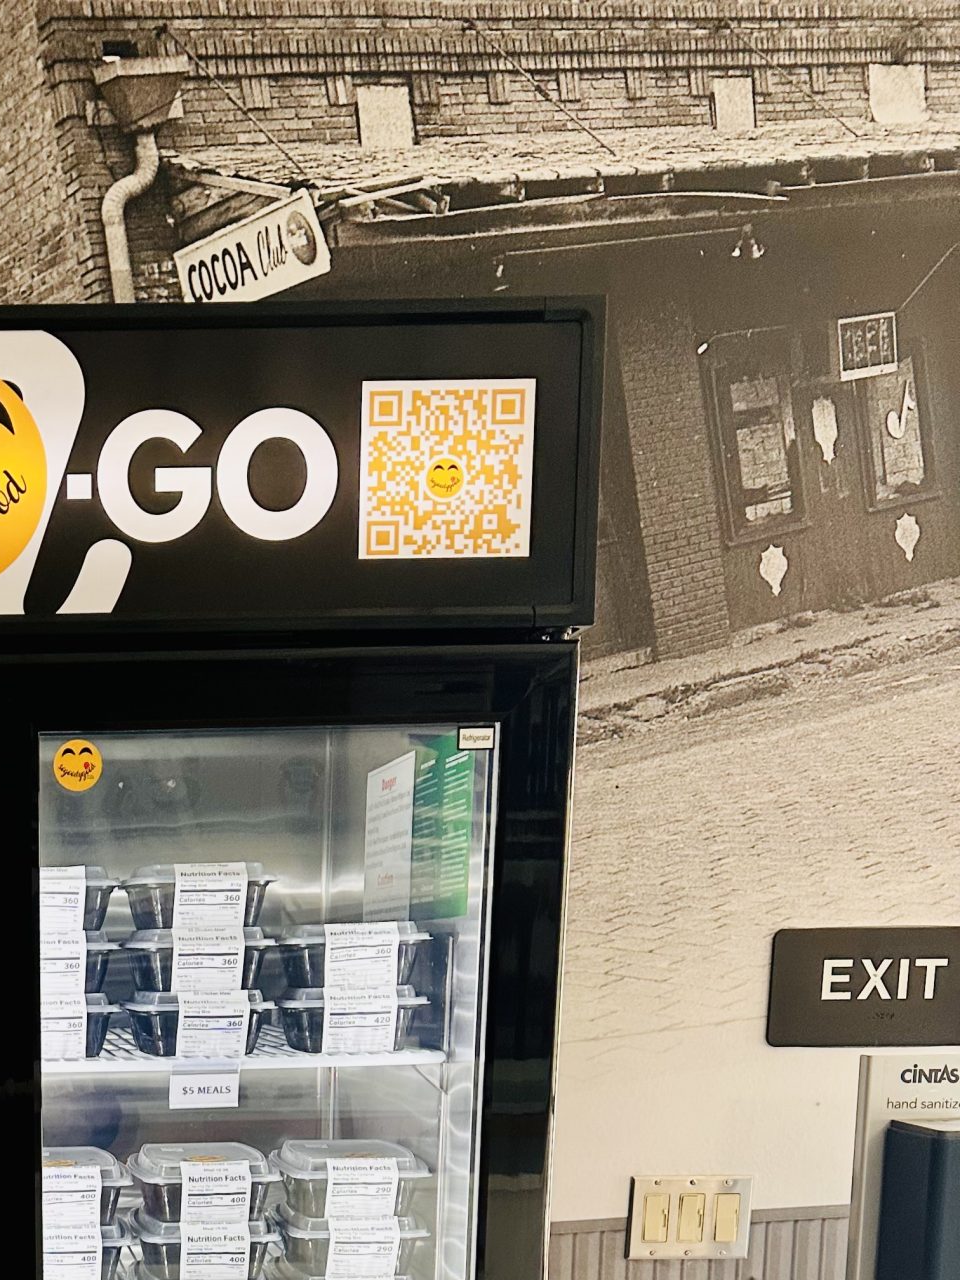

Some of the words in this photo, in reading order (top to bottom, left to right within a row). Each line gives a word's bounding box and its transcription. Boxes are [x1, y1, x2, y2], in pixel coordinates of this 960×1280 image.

[188, 241, 258, 302] COCOA
[257, 224, 288, 277] Club
[821, 959, 948, 1000] EXIT
[182, 1087, 194, 1095] $5
[197, 1086, 231, 1094] MEALS
[887, 1098, 917, 1109] hand
